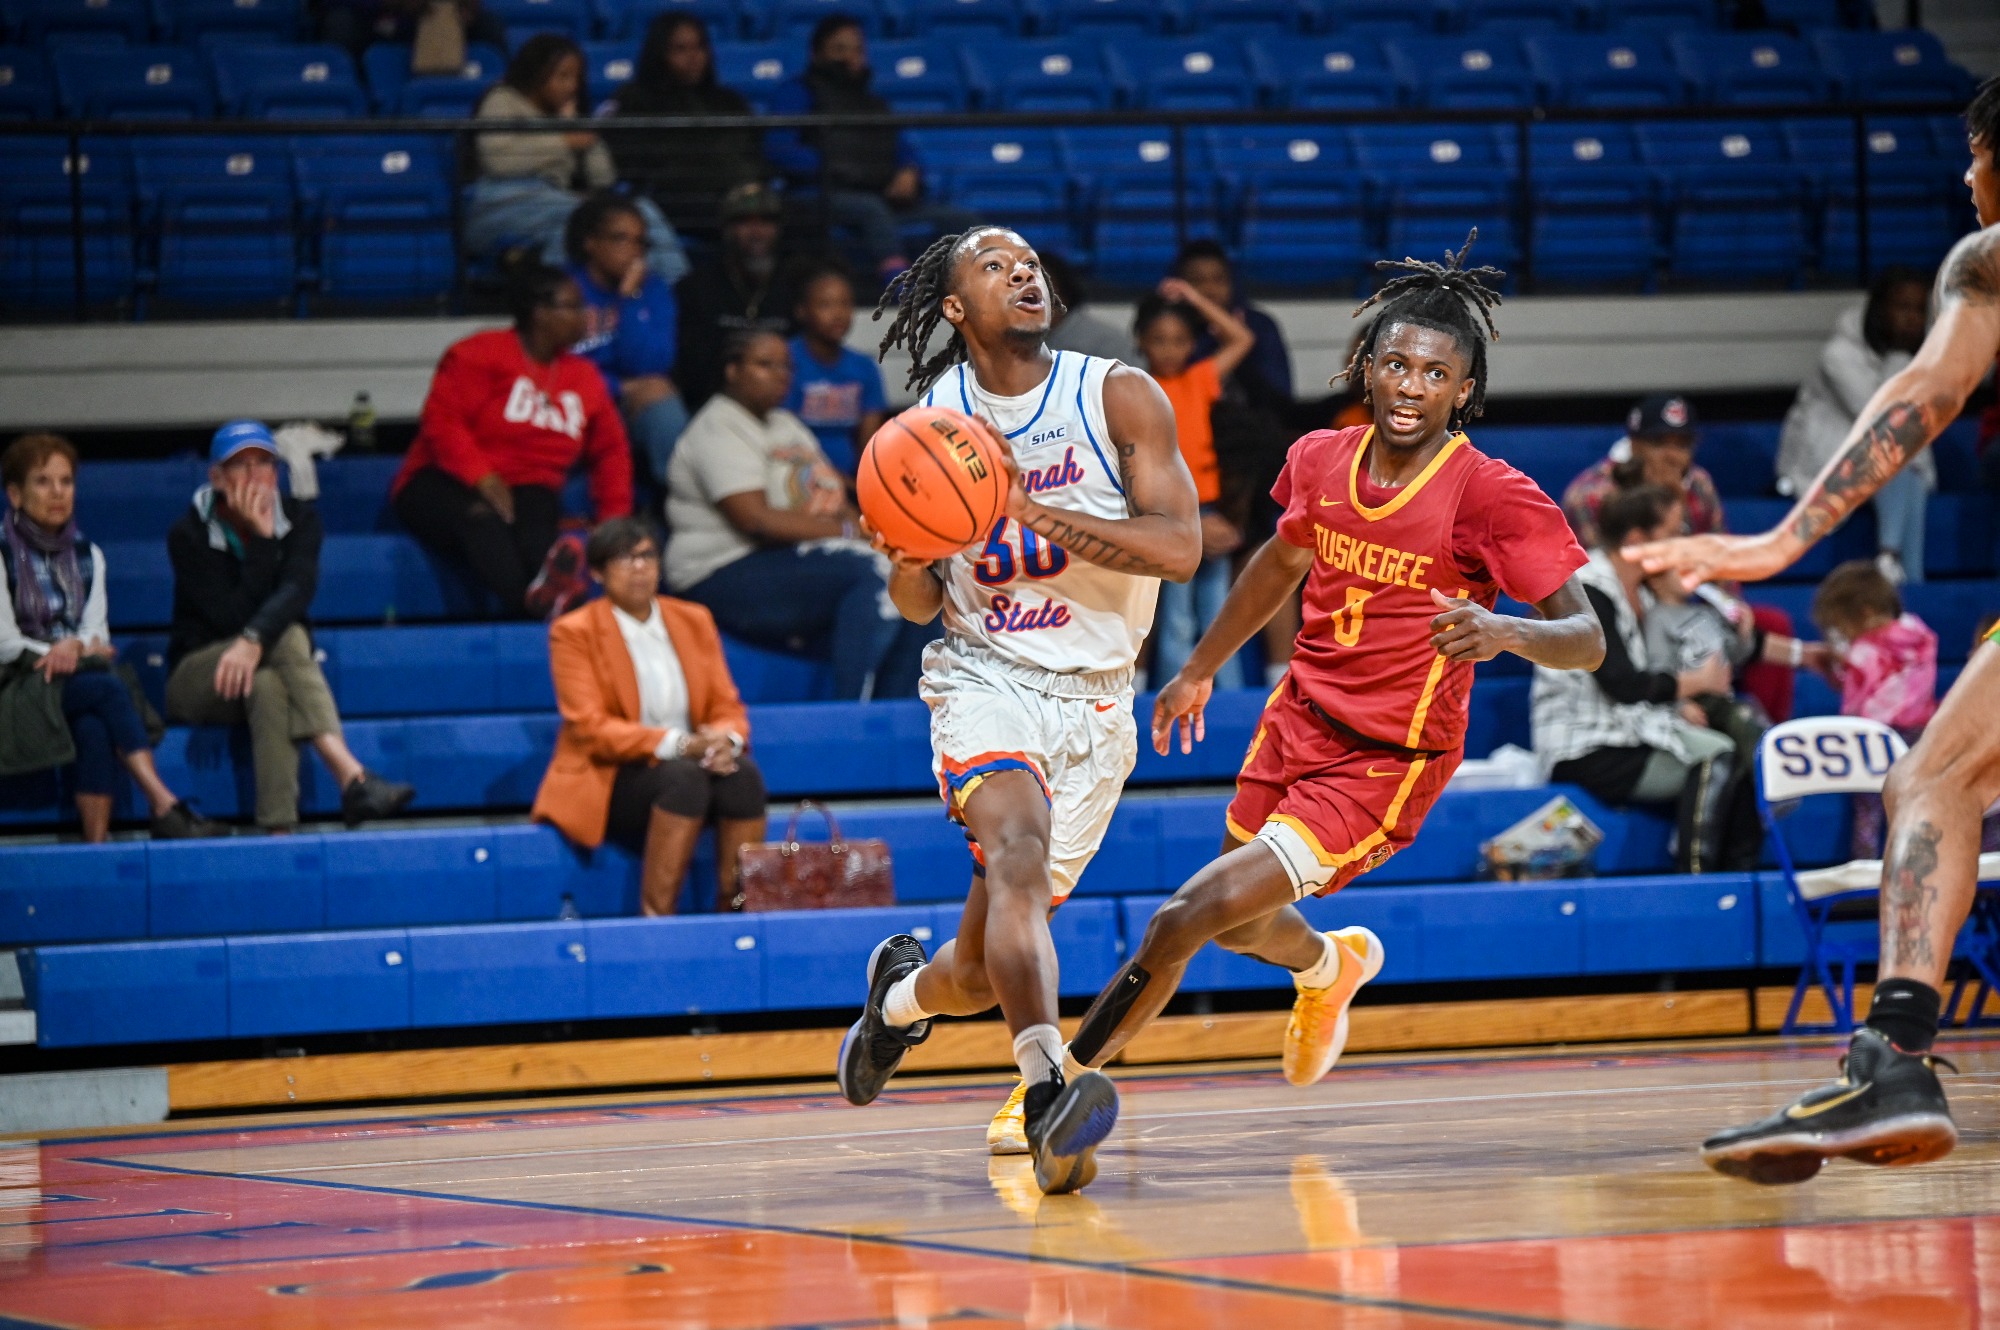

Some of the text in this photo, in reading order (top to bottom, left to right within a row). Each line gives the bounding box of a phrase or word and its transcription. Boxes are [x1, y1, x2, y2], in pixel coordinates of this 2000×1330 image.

[930, 418, 988, 484] ELITE
[1031, 426, 1066, 446] SIAC
[1313, 522, 1434, 590] TUSKEGEE
[985, 593, 1071, 633] State
[1331, 586, 1374, 648] 0
[1773, 732, 1896, 778] SSU
[1128, 973, 1139, 984] KT
